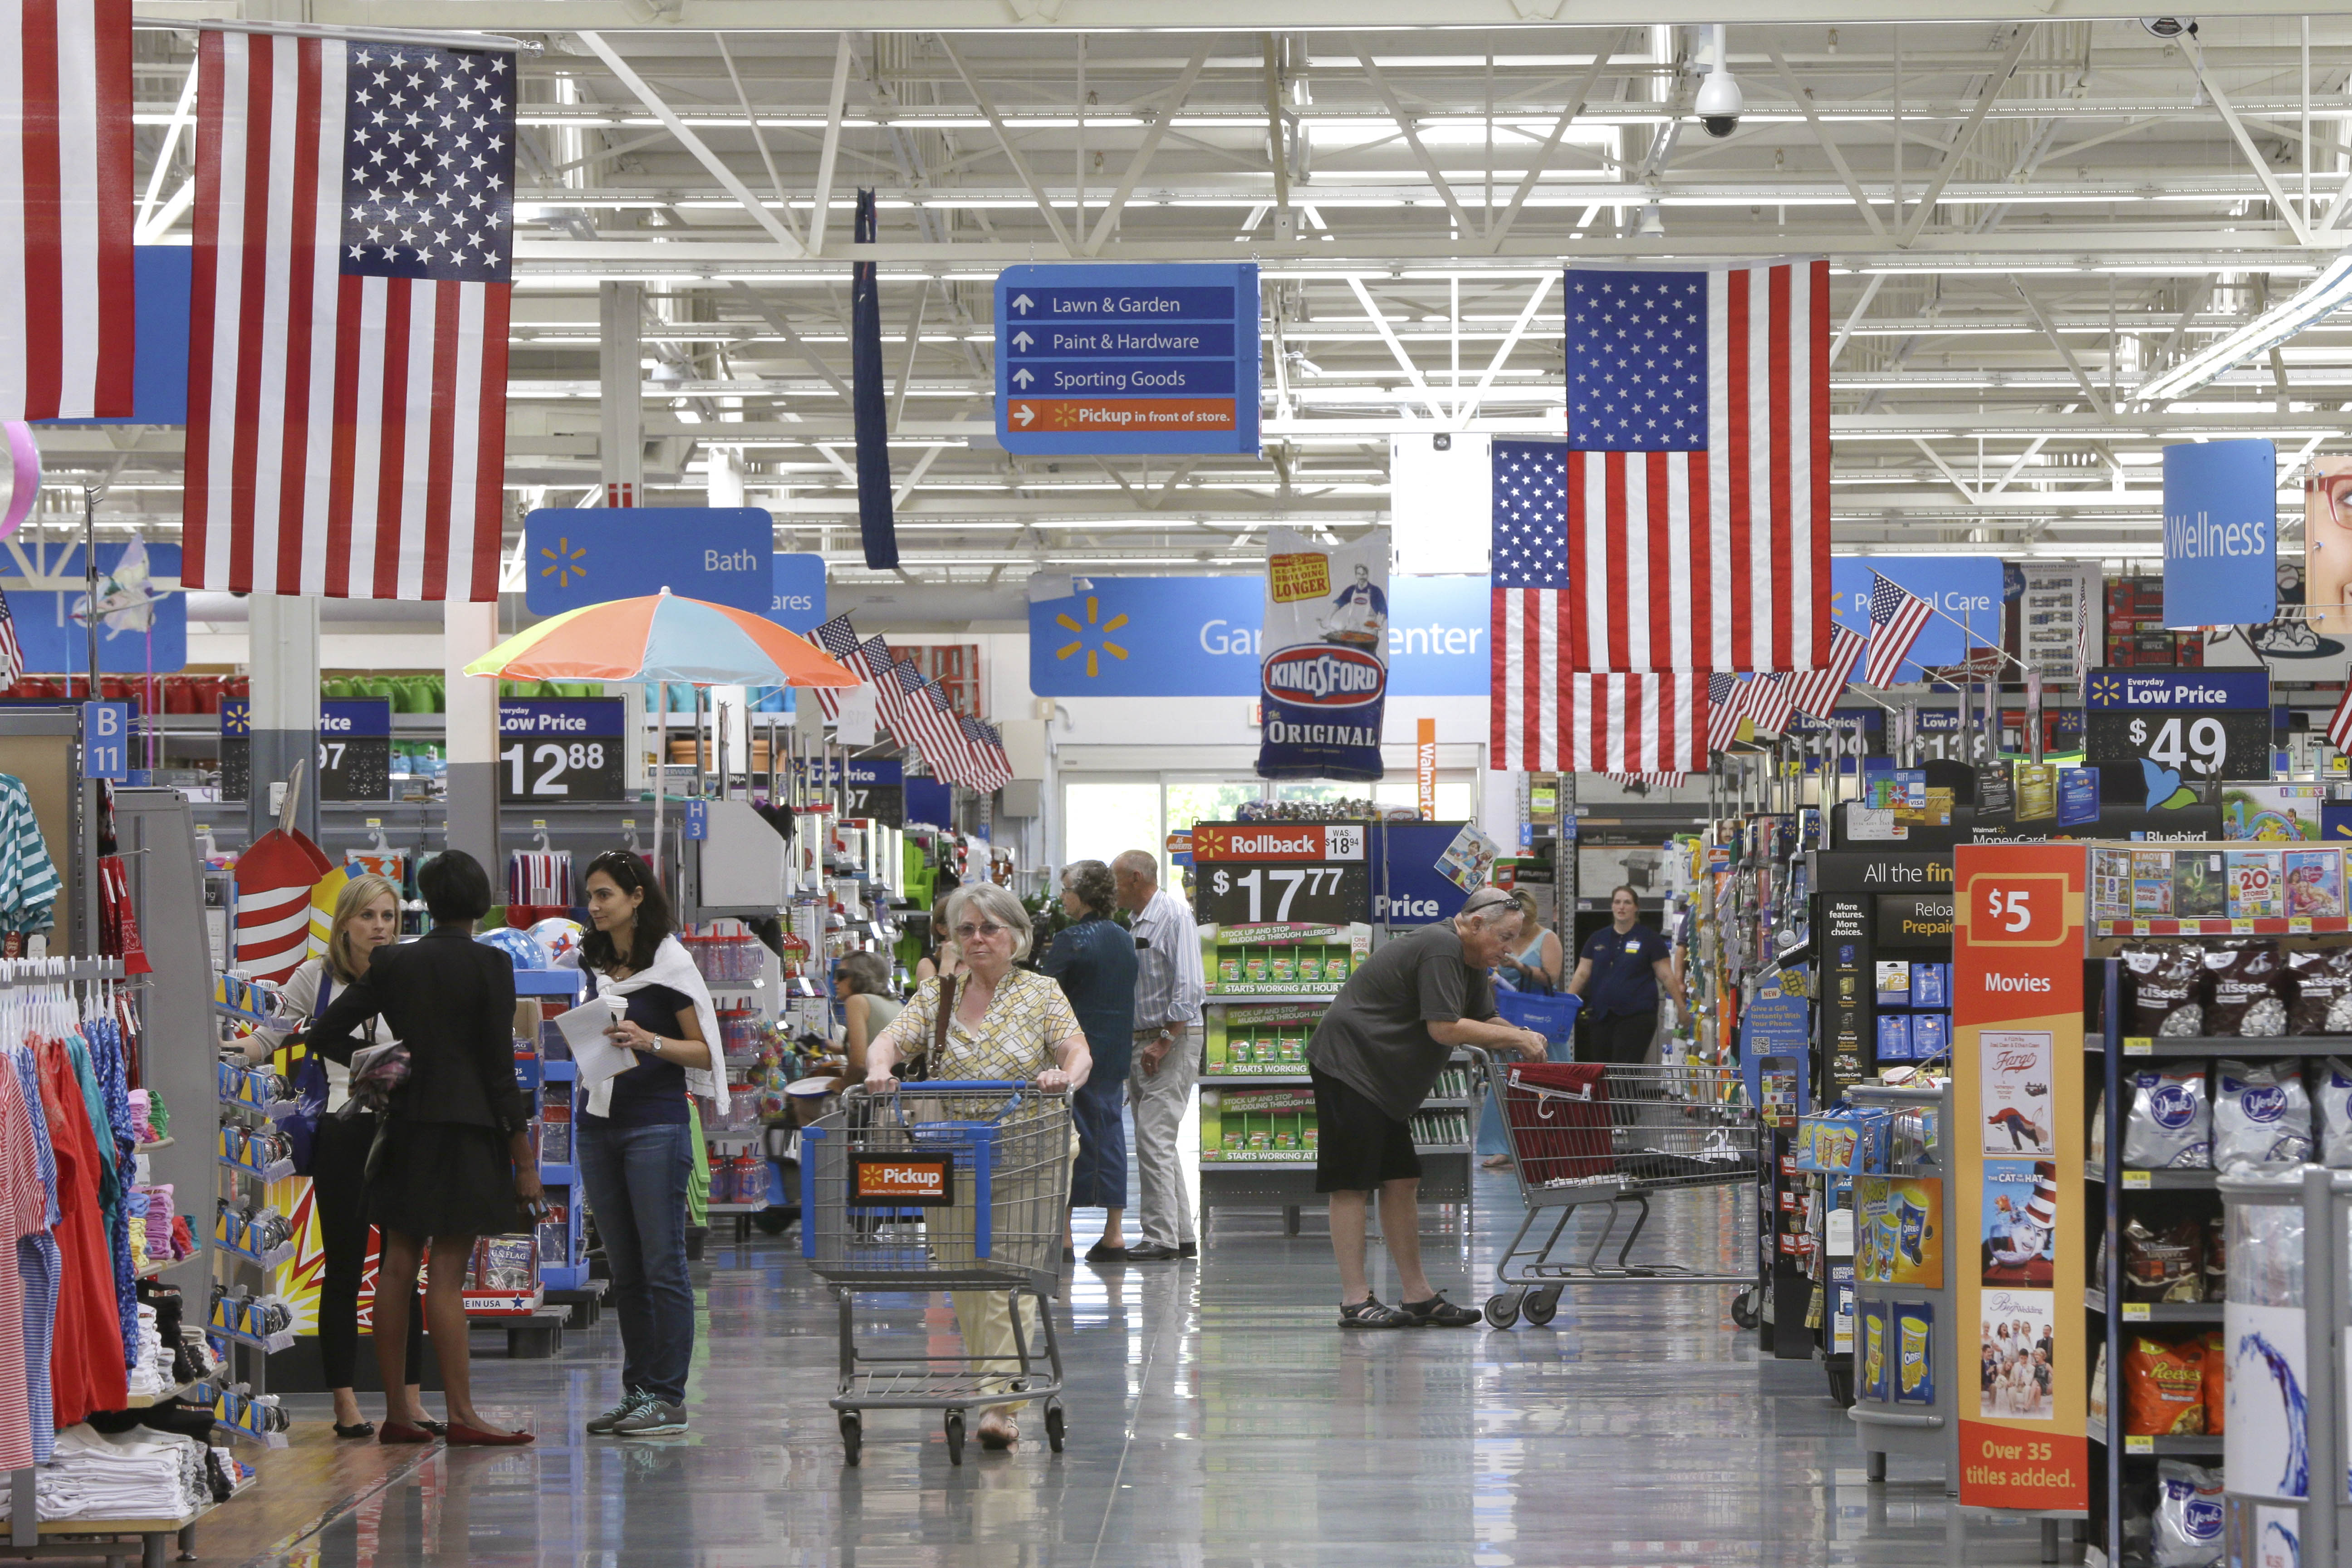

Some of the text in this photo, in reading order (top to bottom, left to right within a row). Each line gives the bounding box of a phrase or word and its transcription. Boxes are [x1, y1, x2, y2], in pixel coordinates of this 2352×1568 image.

[1053, 297, 1180, 313] Lawn & Garden
[1054, 333, 1199, 349] Paint & Hardware
[1054, 371, 1185, 390] Sporting Goods
[1079, 408, 1230, 425] Pickup in front of store.
[2171, 511, 2265, 559] Wellness
[705, 549, 757, 571] Bath
[1275, 578, 1327, 598] LONGER
[1945, 592, 1989, 610] Care
[1390, 627, 1482, 655] enter
[1270, 656, 1378, 700] KINGSFORD
[2127, 678, 2164, 686] Everyday
[2127, 685, 2227, 703] Low Price
[97, 708, 118, 736] B
[499, 714, 586, 730] Low Price
[1268, 710, 1280, 720] The
[1801, 715, 1824, 728] Low
[1923, 718, 1947, 727] Low
[1269, 720, 1376, 746] ORIGINAL
[2129, 717, 2226, 774] $49
[94, 746, 118, 771] 11
[1420, 743, 1433, 807] Walmart
[1896, 773, 1909, 781] GIFT
[2282, 788, 2320, 796] INTEX
[690, 802, 703, 816] H
[692, 823, 701, 835] 3
[1566, 817, 1574, 825] G
[1565, 829, 1576, 837] 33
[1974, 834, 2046, 844] MoneyCard
[2146, 831, 2206, 841] Bluebird
[1231, 835, 1315, 854] Rollback
[1864, 863, 1922, 882] All the
[2239, 870, 2269, 890] 20
[1374, 894, 1439, 917] Price
[1829, 910, 1865, 918] features.
[1989, 888, 2031, 932] $5
[1221, 930, 1243, 938] STOCK
[1256, 927, 1271, 936] AND
[1229, 927, 1336, 944] MUDDLING THROUGH ALLERGIES
[1891, 975, 1906, 984] $25
[1985, 973, 2051, 992] Movies
[1230, 1010, 1251, 1018] STOCK
[1281, 1005, 1298, 1014] STOP
[1238, 1012, 1310, 1024] MUDDLING THROUGH
[1993, 1050, 2037, 1077] Fargo
[1231, 1103, 1268, 1111] MUDDLING
[2158, 1094, 2195, 1120] York
[2249, 1088, 2282, 1112] York
[884, 1168, 940, 1187] Pickup
[1999, 1173, 2016, 1182] CAT
[2025, 1174, 2044, 1183] HAT
[1903, 1225, 1920, 1233] OREO
[505, 1251, 526, 1260] FLAG
[1905, 1352, 1921, 1366] OREO
[2149, 1361, 2202, 1382] Reese's
[1982, 1440, 2052, 1460] Over 35
[1966, 1465, 2076, 1488] titles added.
[2190, 1511, 2222, 1527] York
